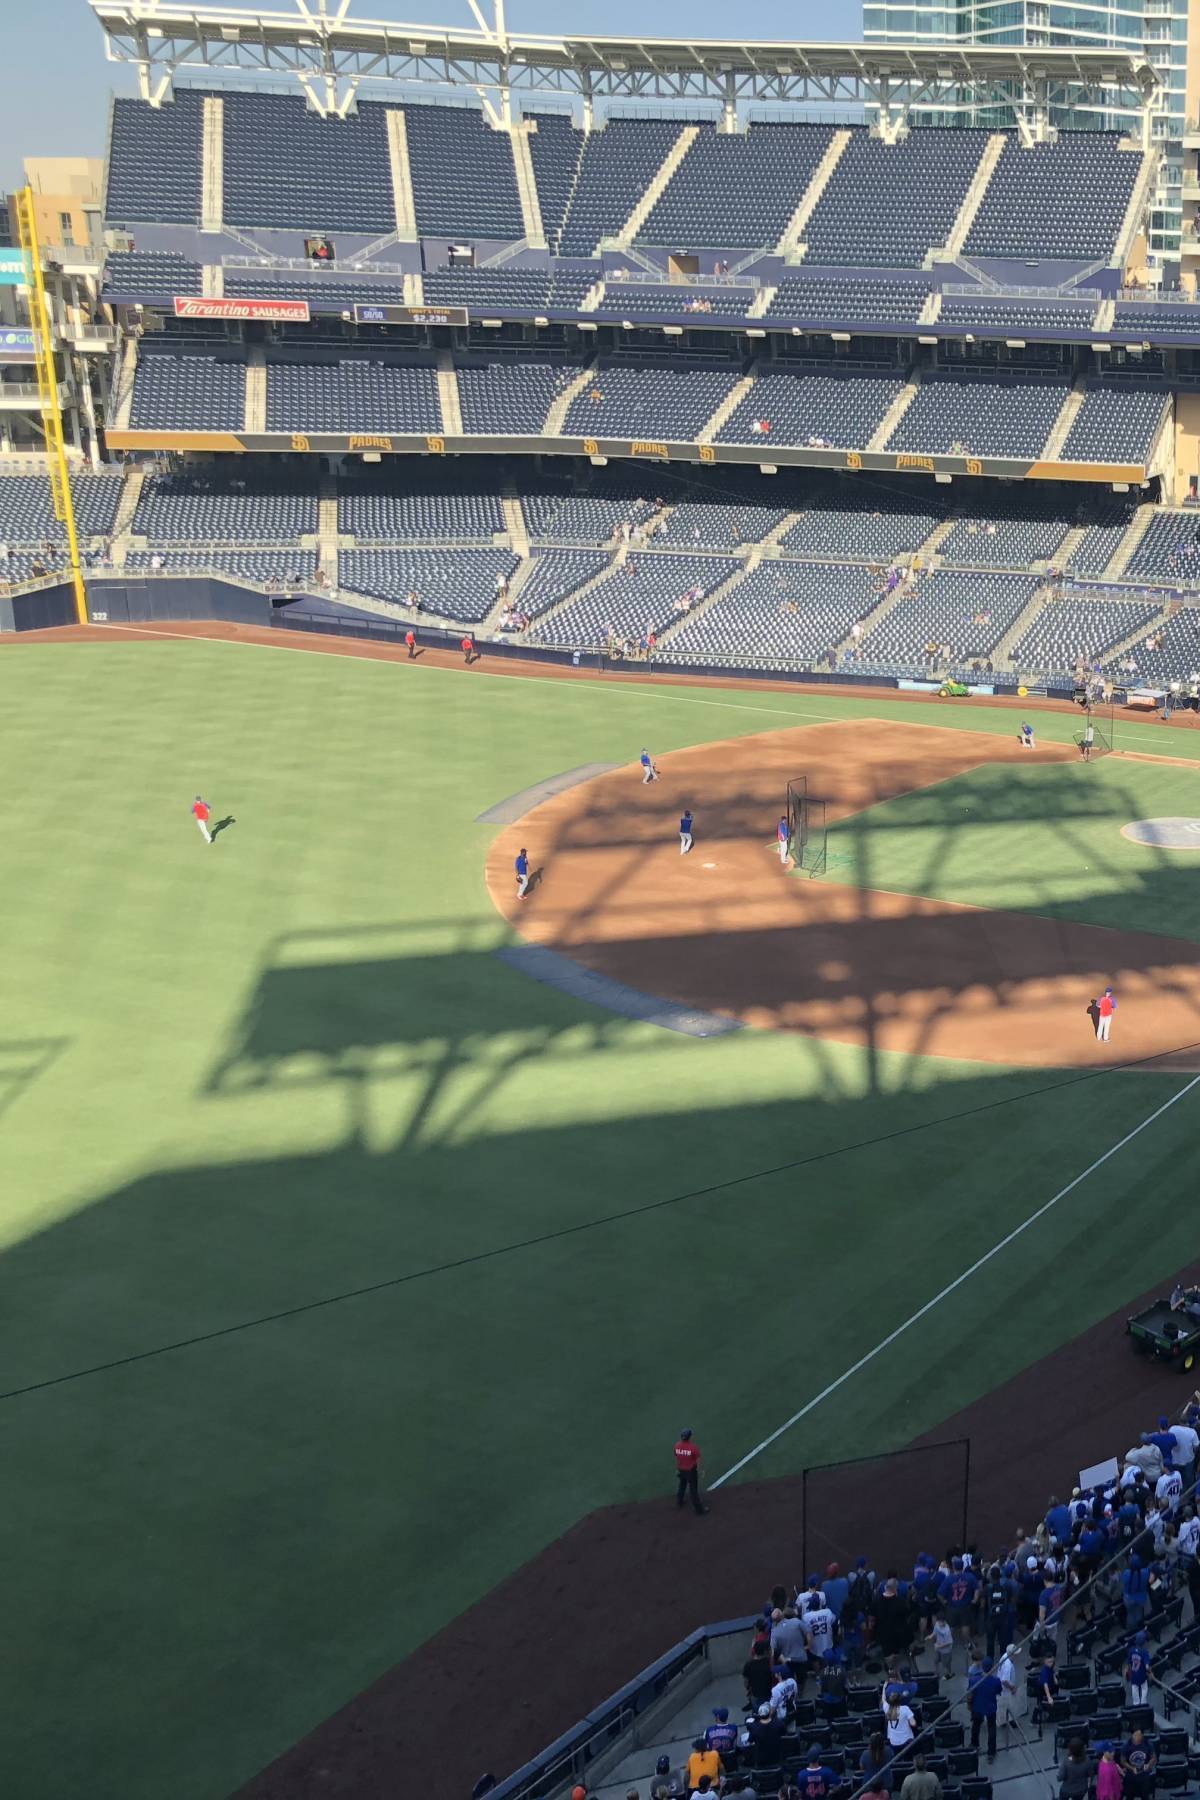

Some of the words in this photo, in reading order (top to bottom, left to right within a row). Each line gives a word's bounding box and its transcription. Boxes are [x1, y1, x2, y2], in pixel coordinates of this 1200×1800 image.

[179, 300, 249, 316] Tarantino
[249, 306, 305, 318] SAUSAGES
[349, 435, 392, 451] PADRES
[631, 442, 669, 458] PADRES
[896, 455, 934, 471] PADRES
[812, 1623, 828, 1636] 23
